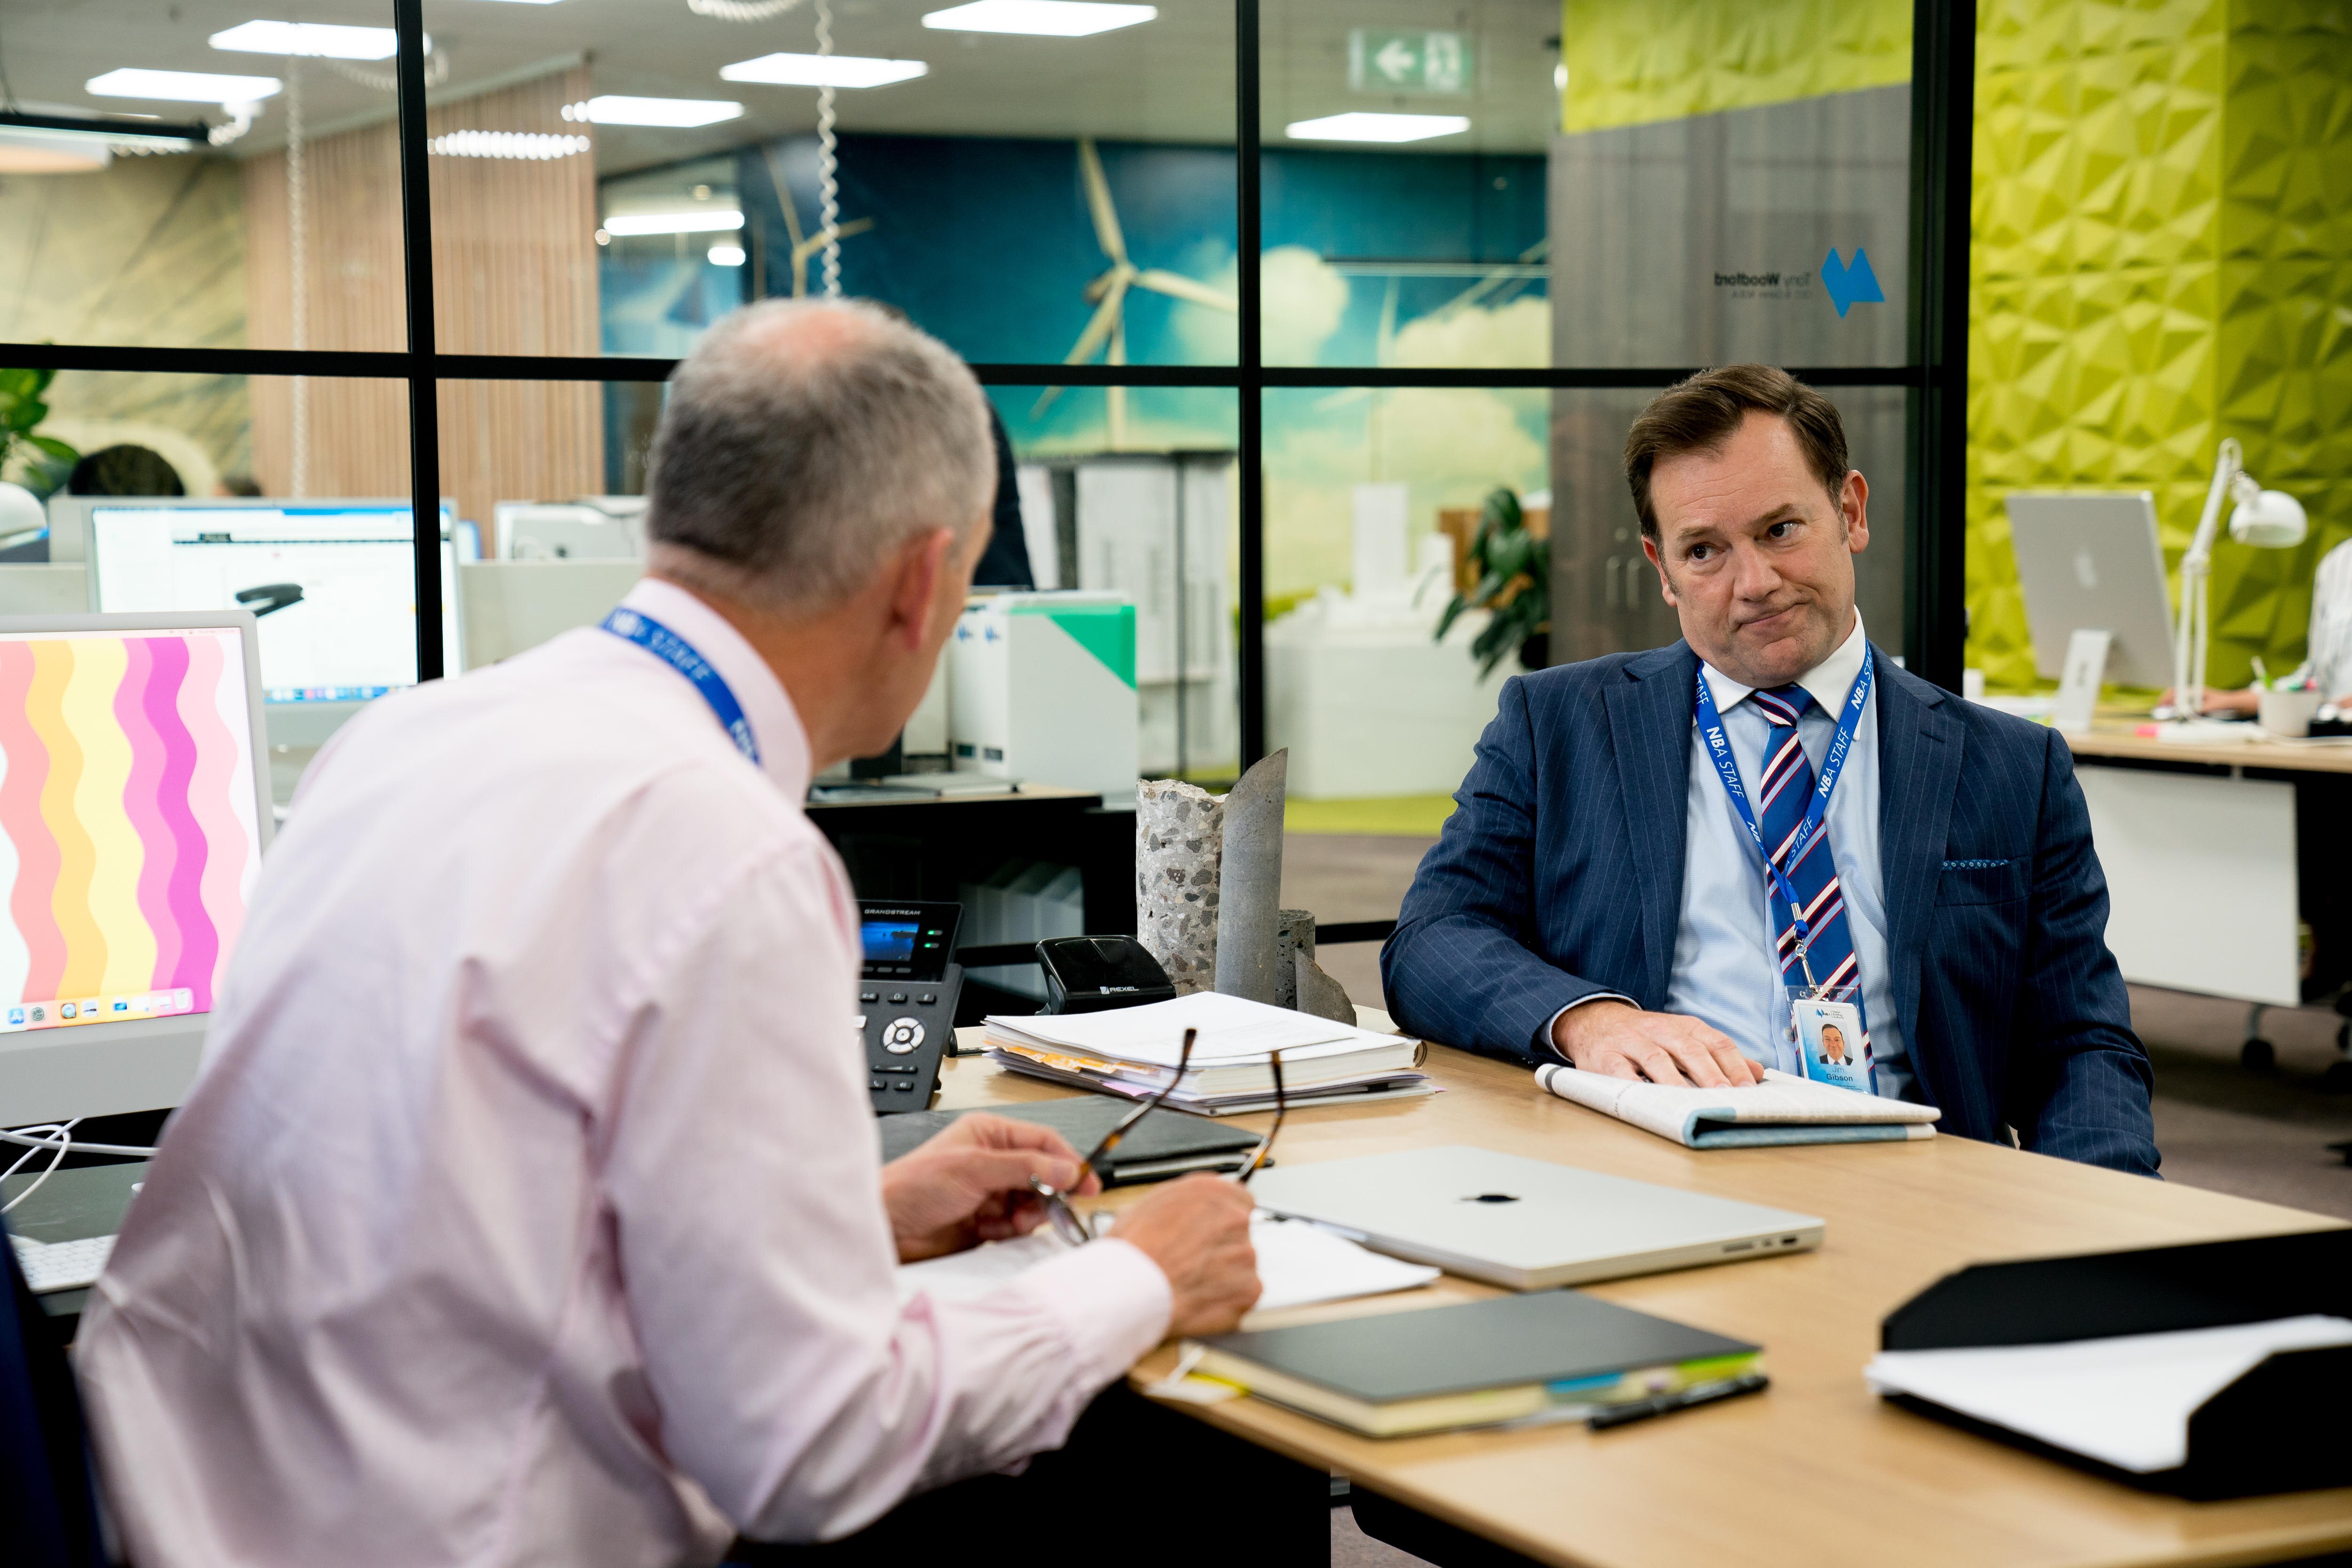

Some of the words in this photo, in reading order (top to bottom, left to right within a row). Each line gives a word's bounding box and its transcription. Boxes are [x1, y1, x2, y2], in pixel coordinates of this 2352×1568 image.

[1851, 680, 1867, 710] NBA
[1706, 726, 1728, 757] NBA
[1719, 761, 1744, 798] STAFF
[1819, 768, 1836, 798] NBA
[1830, 726, 1849, 767] STAFF
[1791, 815, 1812, 858] STAFF
